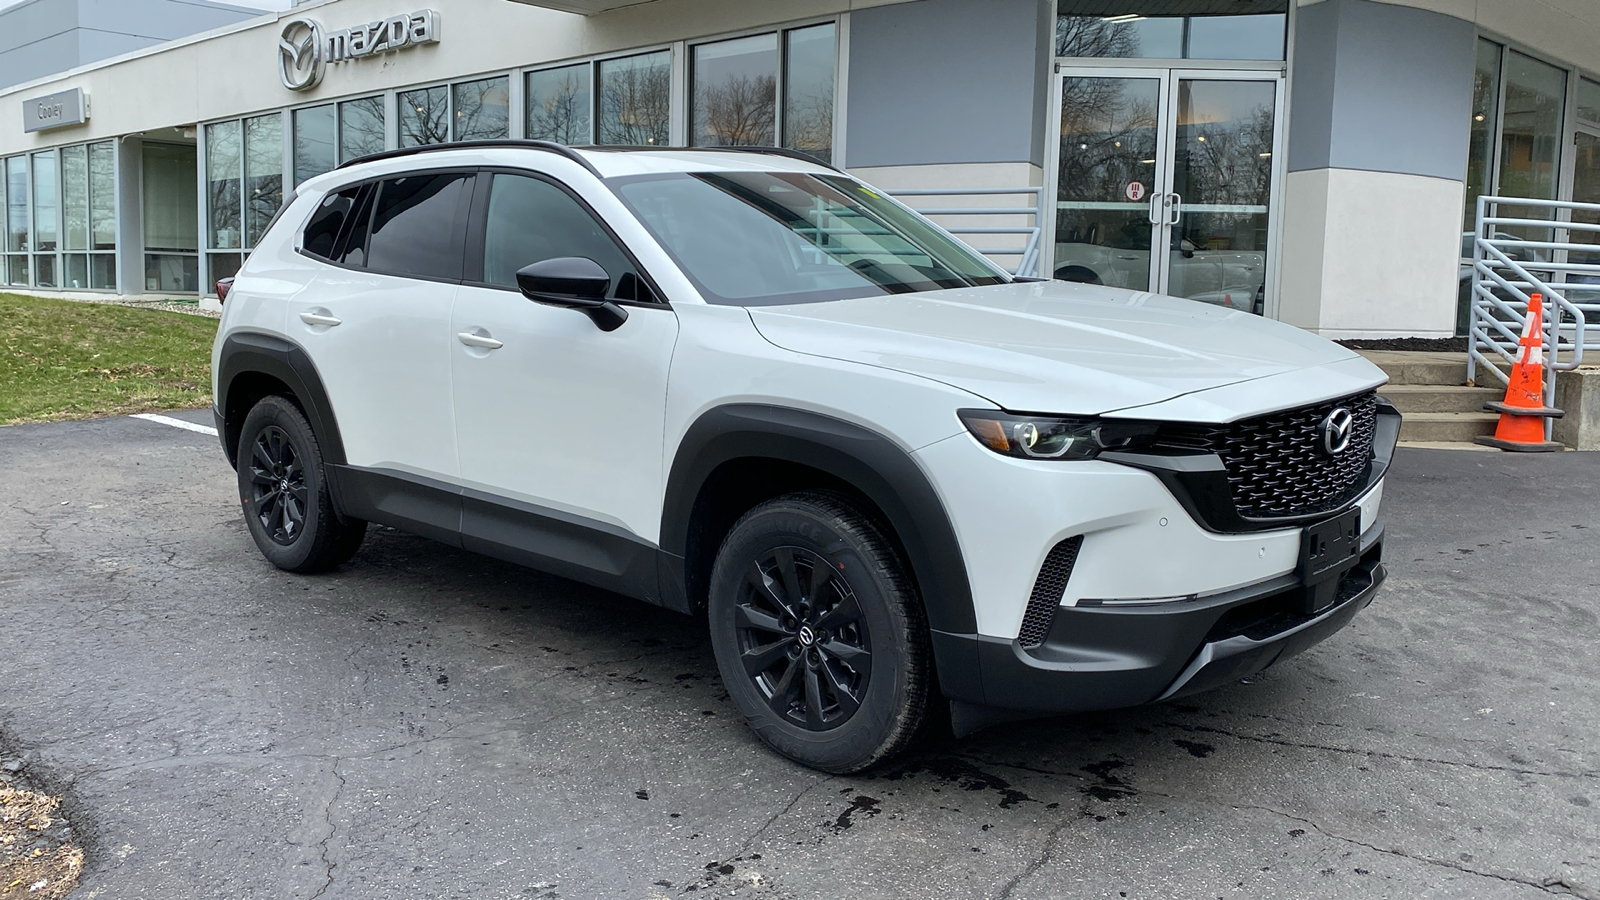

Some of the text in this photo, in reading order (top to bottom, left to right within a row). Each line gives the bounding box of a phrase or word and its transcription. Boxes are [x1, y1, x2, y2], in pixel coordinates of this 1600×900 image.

[326, 9, 439, 63] mazda
[38, 98, 63, 121] Cooley
[1132, 191, 1138, 199] R
